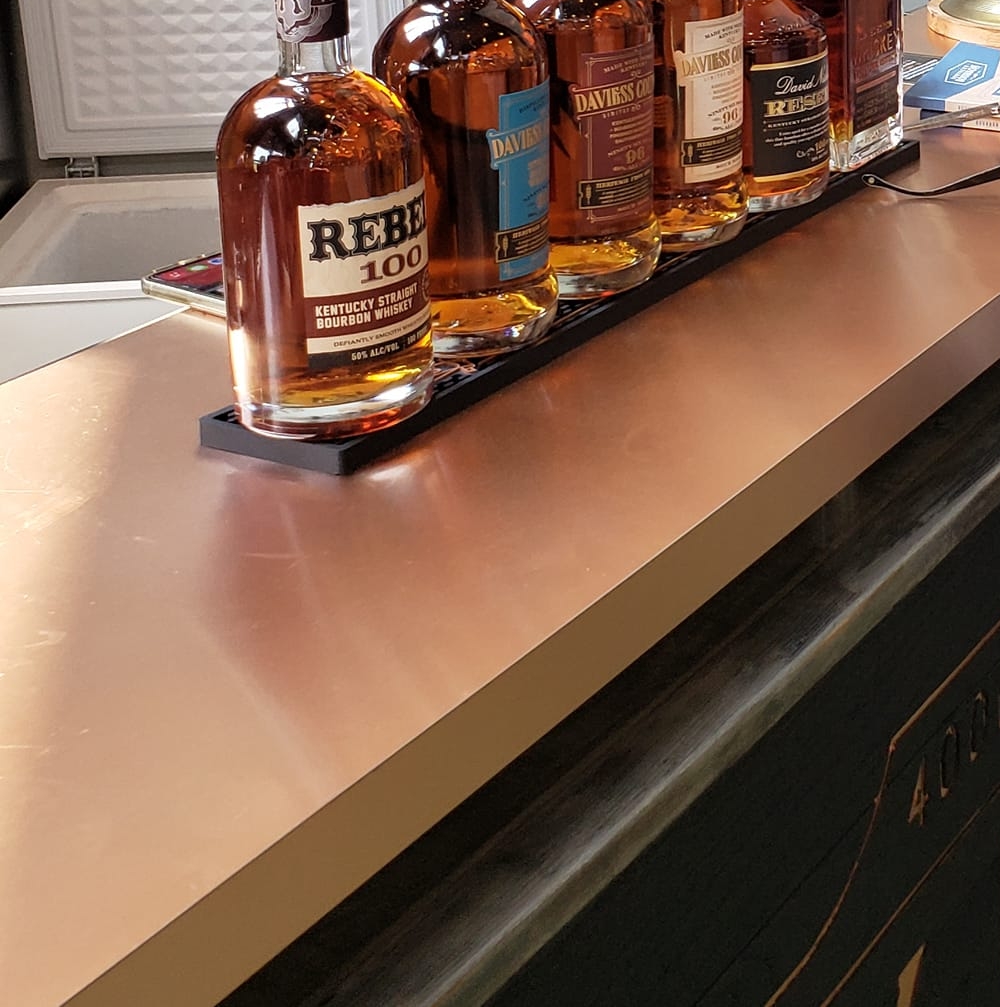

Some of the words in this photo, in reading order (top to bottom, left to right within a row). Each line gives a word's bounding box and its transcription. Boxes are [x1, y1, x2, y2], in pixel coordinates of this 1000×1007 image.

[682, 48, 730, 77] DAVIESS
[574, 82, 634, 113] DAVIESS
[774, 75, 820, 96] David
[307, 191, 426, 263] REBE
[359, 244, 422, 284] 100
[315, 297, 376, 318] KENTUCKY
[378, 282, 418, 306] STRAIGHT
[316, 311, 372, 330] BOURBON
[374, 297, 414, 321] WHISKEY
[369, 341, 400, 358] ALC/VOL
